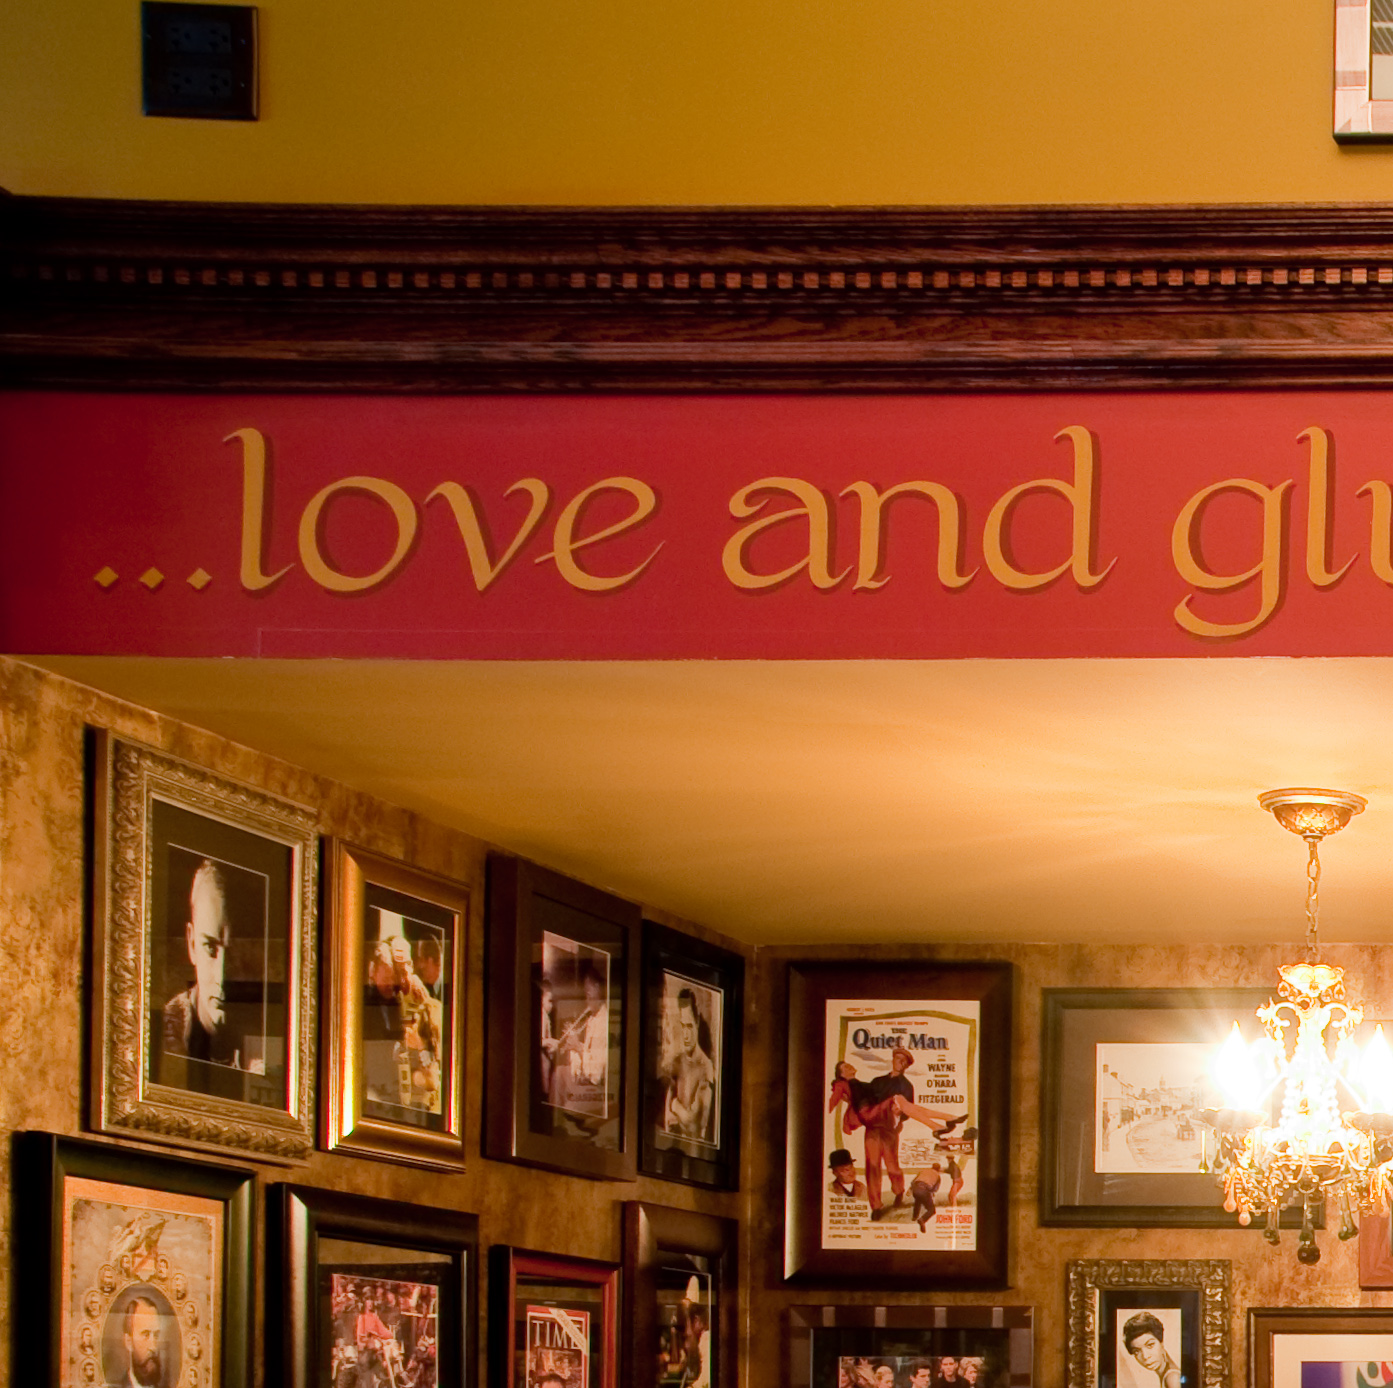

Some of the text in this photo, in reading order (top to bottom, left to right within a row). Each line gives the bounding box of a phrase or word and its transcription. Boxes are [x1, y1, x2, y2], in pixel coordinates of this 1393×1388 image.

[722, 424, 1117, 592] and
[852, 1027, 950, 1051] Quiet Man
[927, 1063, 957, 1073] WAYNE
[926, 1079, 957, 1089] O'HARA
[918, 1094, 965, 1104] FITZGERALD
